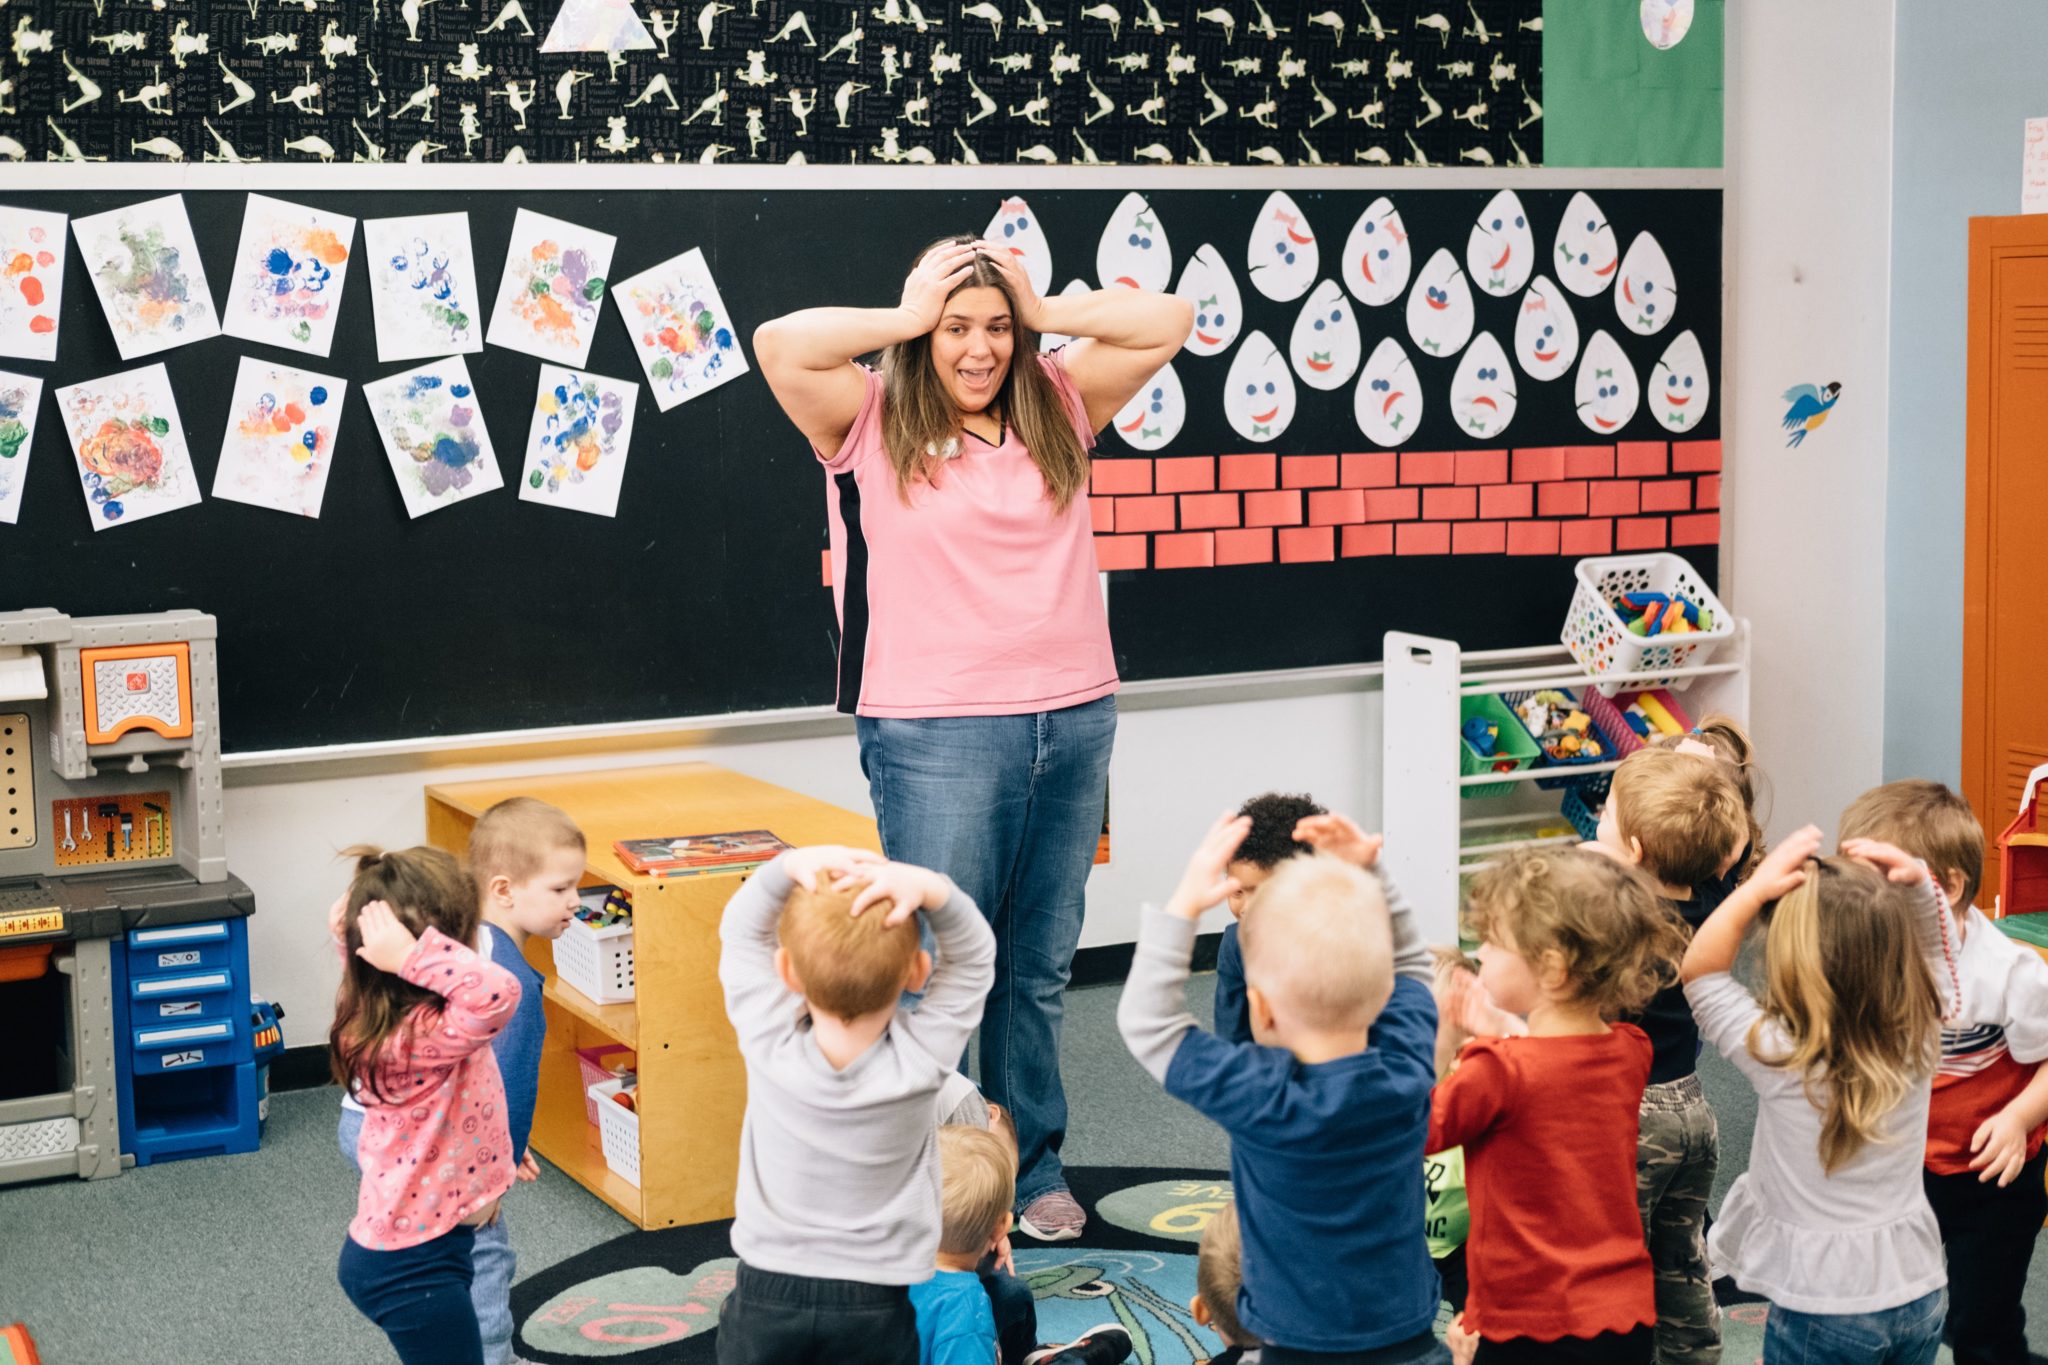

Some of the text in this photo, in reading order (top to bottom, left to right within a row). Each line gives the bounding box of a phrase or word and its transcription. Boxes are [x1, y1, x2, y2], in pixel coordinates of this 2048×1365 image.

[168, 2, 192, 11] Relax
[230, 59, 264, 69] Be Strong
[283, 60, 293, 69] Be
[578, 1301, 711, 1344] 10
